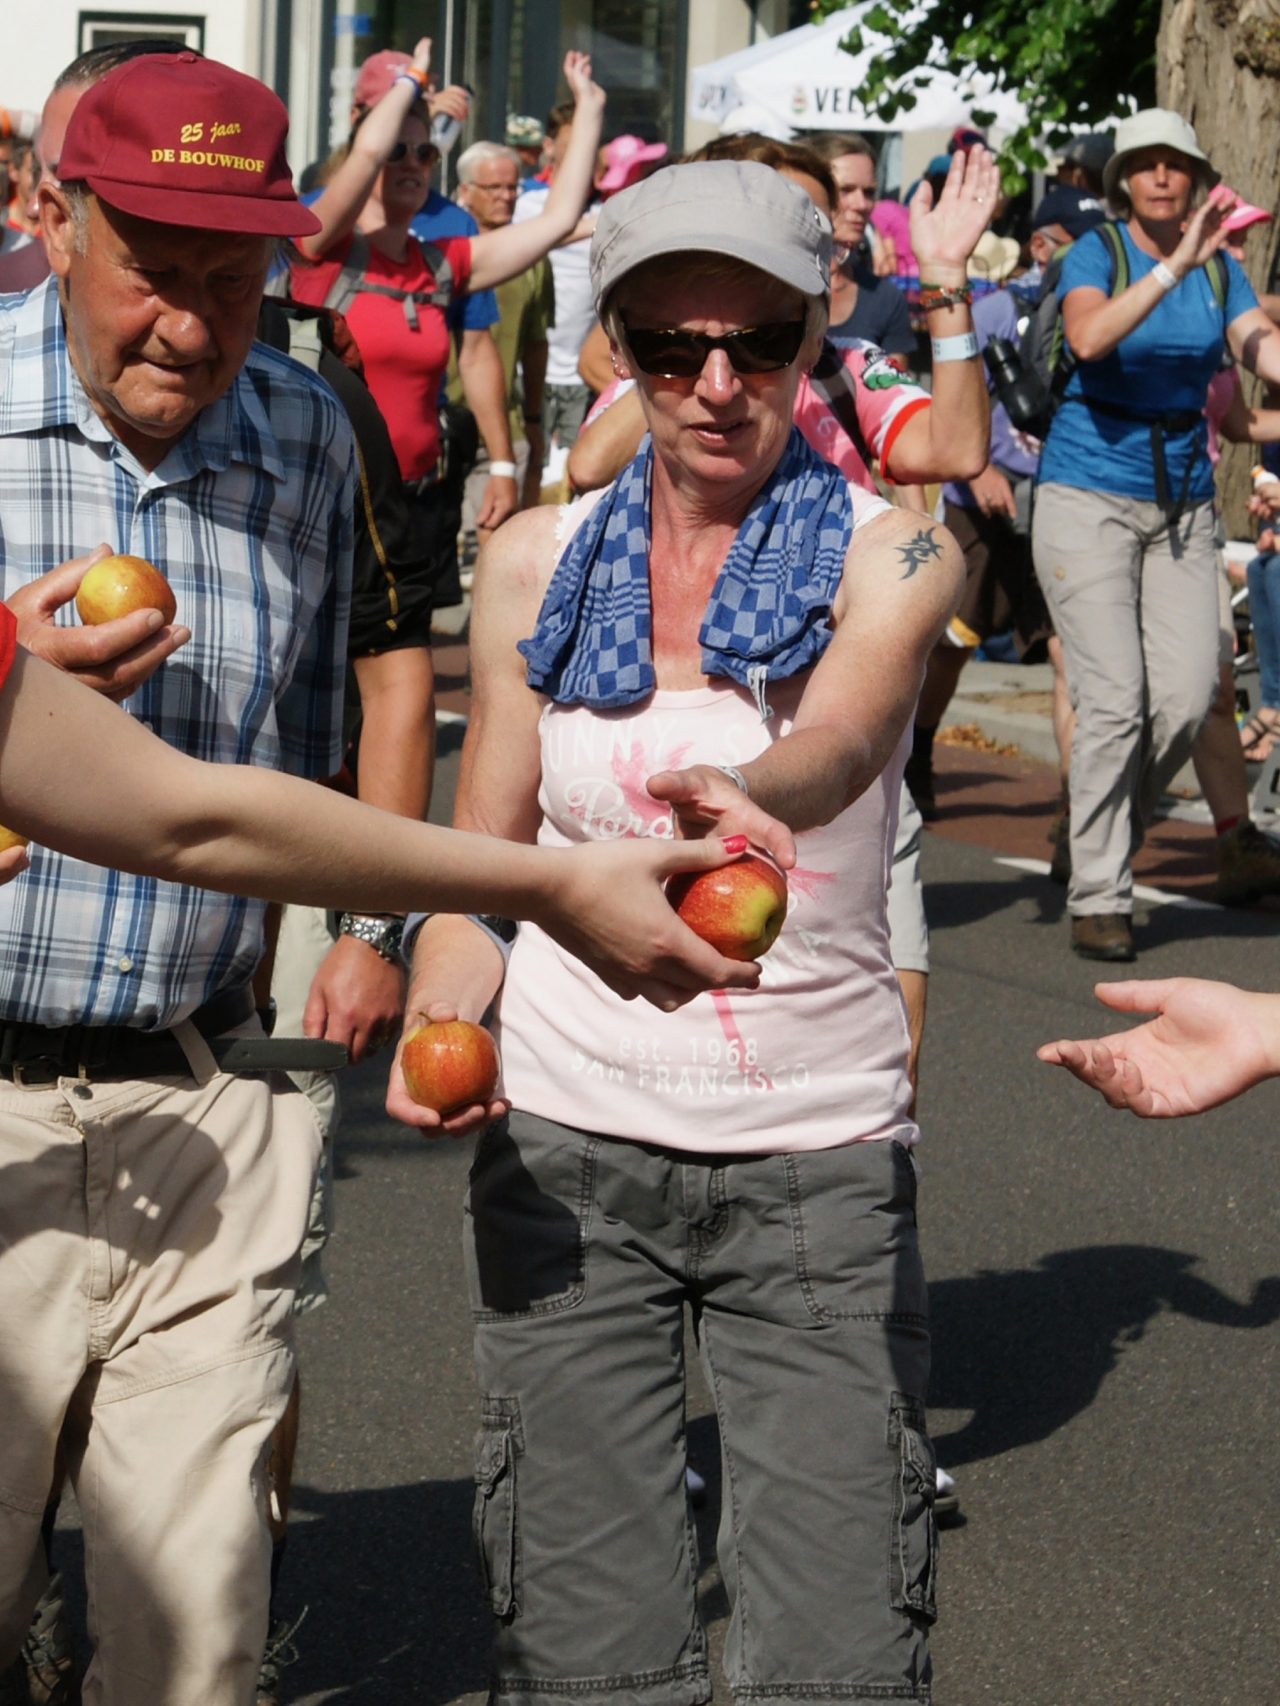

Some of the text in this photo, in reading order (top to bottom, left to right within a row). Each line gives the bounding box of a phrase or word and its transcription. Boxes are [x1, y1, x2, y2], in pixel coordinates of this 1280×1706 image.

[815, 87, 857, 113] VEL
[180, 121, 241, 144] 25 jaar
[151, 149, 264, 172] DE BOUWHOF
[547, 716, 677, 774] UNNY
[562, 776, 674, 841] Para
[689, 1037, 760, 1068] 1968
